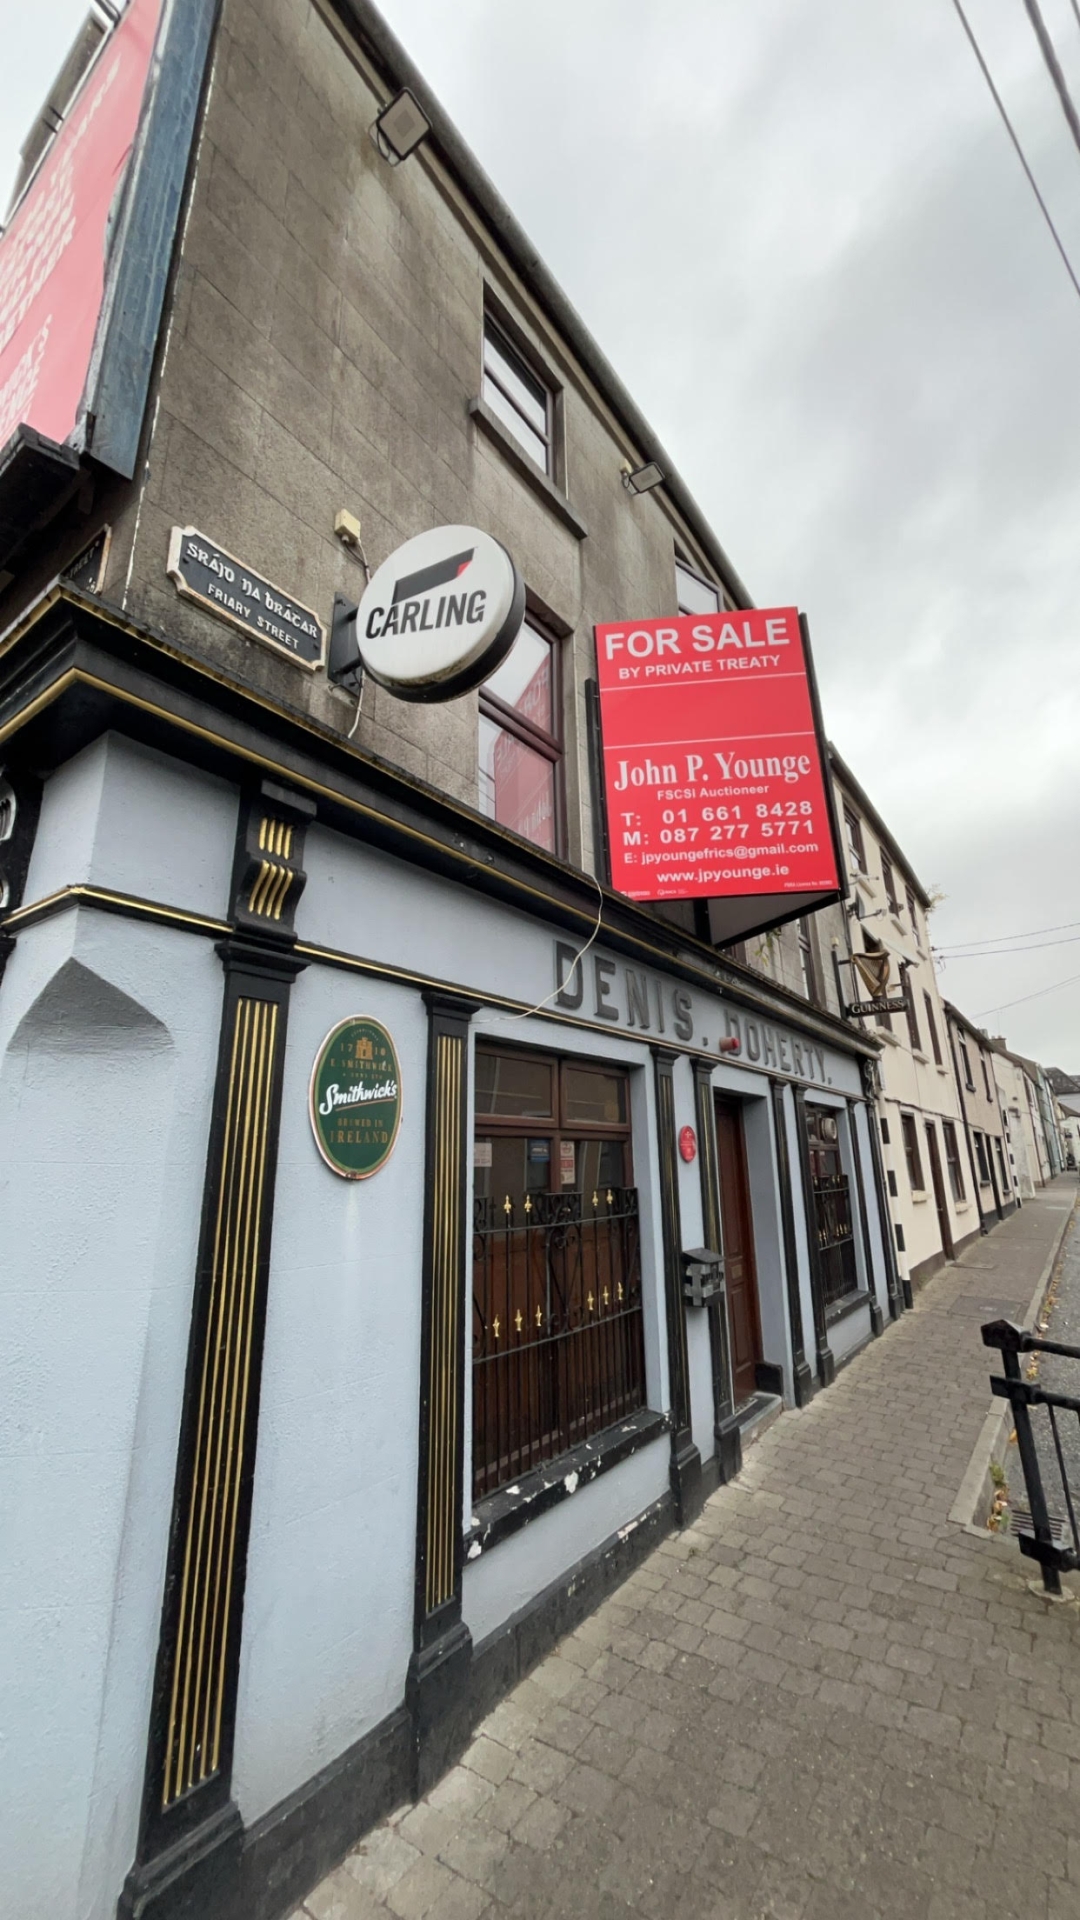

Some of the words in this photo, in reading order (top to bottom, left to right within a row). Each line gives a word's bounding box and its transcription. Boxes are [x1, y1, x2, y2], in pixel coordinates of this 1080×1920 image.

[242, 578, 261, 601] NA
[208, 583, 251, 618] FRIARY
[257, 616, 299, 650] STREET
[365, 590, 487, 639] CARLING
[605, 628, 682, 660] FOR
[692, 618, 790, 652] SALE
[619, 667, 640, 680] BY
[645, 660, 713, 677] PRIVATE
[717, 655, 780, 671] TREATY
[614, 759, 678, 791] John
[685, 754, 709, 783] P.
[712, 752, 811, 784] Younge
[657, 789, 696, 801] FSCSI
[699, 785, 770, 798] Auctioneer
[620, 812, 642, 827] T:
[662, 809, 688, 824] 01
[701, 805, 742, 822] 661
[756, 800, 813, 819] 8428
[623, 831, 649, 846] M:
[659, 827, 699, 844] 087
[709, 823, 749, 841] 277
[761, 819, 814, 837] 5771
[623, 852, 638, 864] E:
[640, 842, 819, 865] jpyoungefrics@gmail.com
[656, 864, 789, 884] www.jpyounge.ie
[851, 1000, 904, 1014] GUINNESS
[319, 1079, 397, 1115] Smithwick's
[330, 1130, 388, 1144] IRELAND
